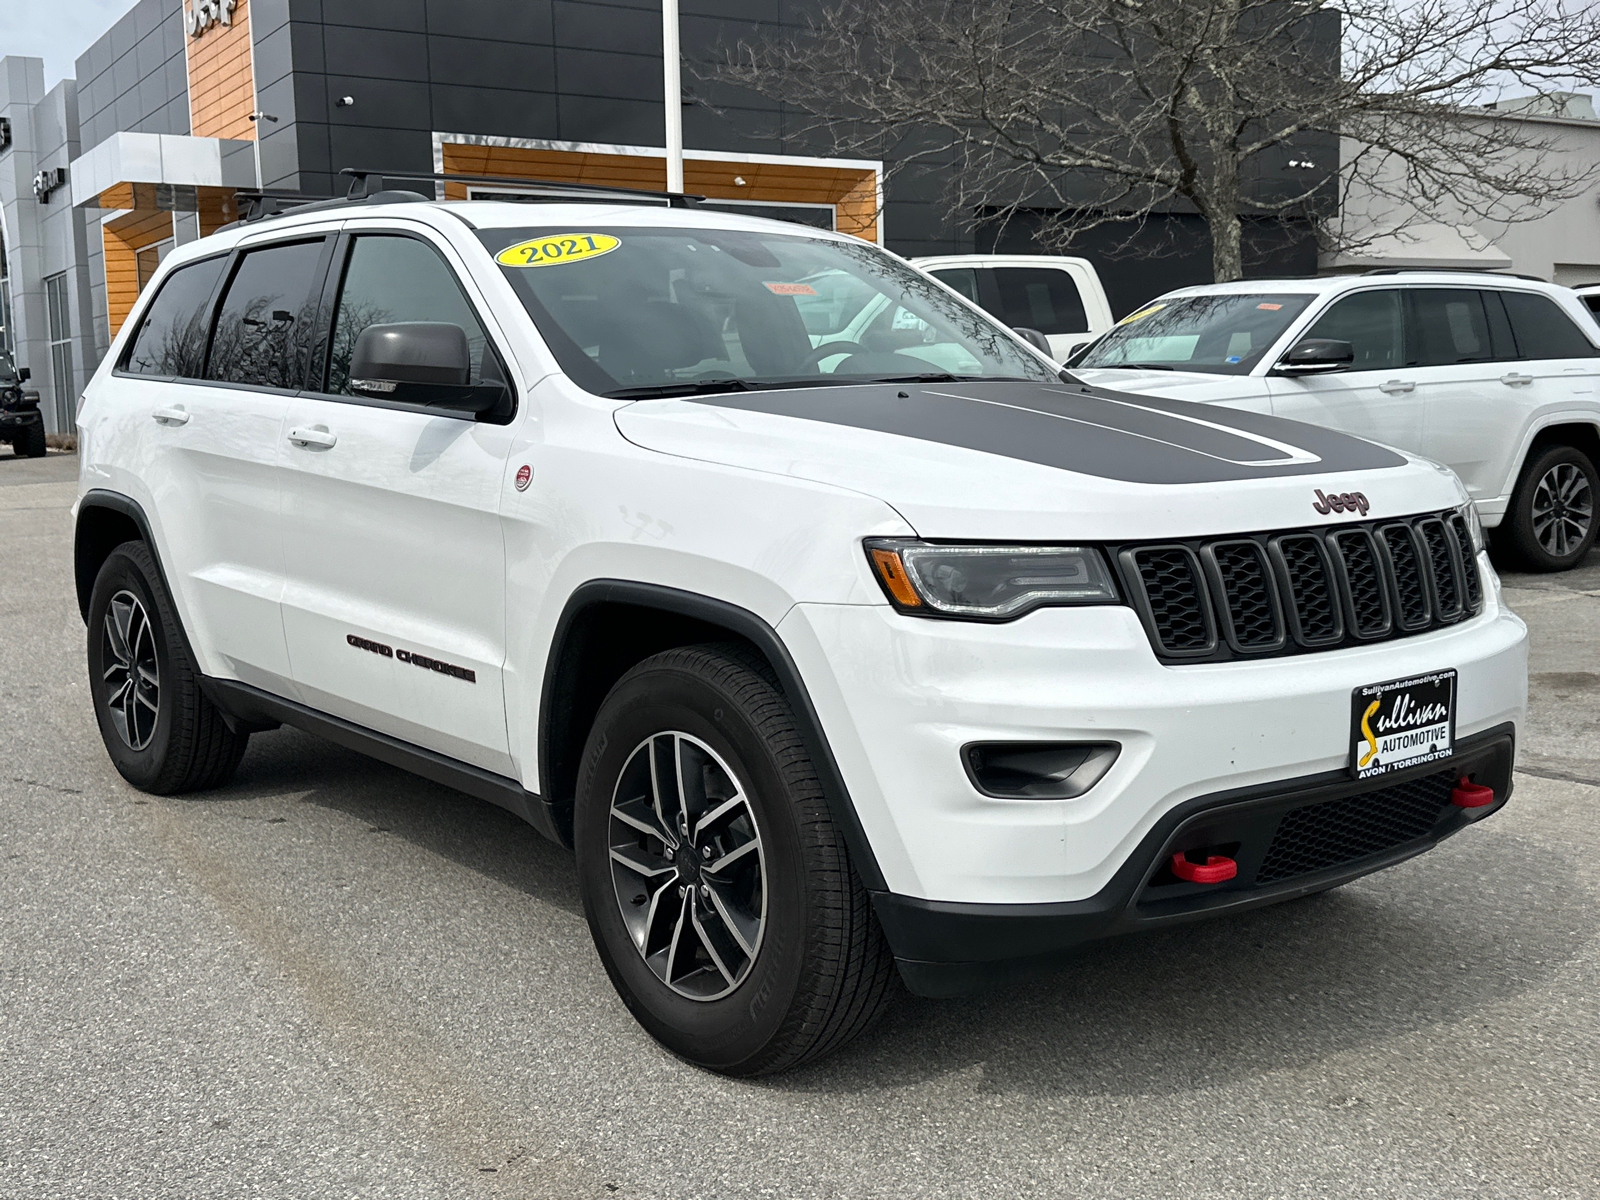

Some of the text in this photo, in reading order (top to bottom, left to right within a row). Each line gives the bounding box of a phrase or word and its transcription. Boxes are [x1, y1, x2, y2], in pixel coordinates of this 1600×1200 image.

[520, 236, 602, 264] 2021
[1312, 489, 1370, 517] Jeep
[346, 634, 476, 683] GRAND CHEROKEE
[1362, 671, 1455, 696] SullivanAutomotive.com
[1359, 693, 1447, 767] Sullivan
[1381, 726, 1446, 754] AUTOMOTIVE
[1359, 765, 1386, 779] AVON
[1392, 748, 1453, 770] TORRINGTON
